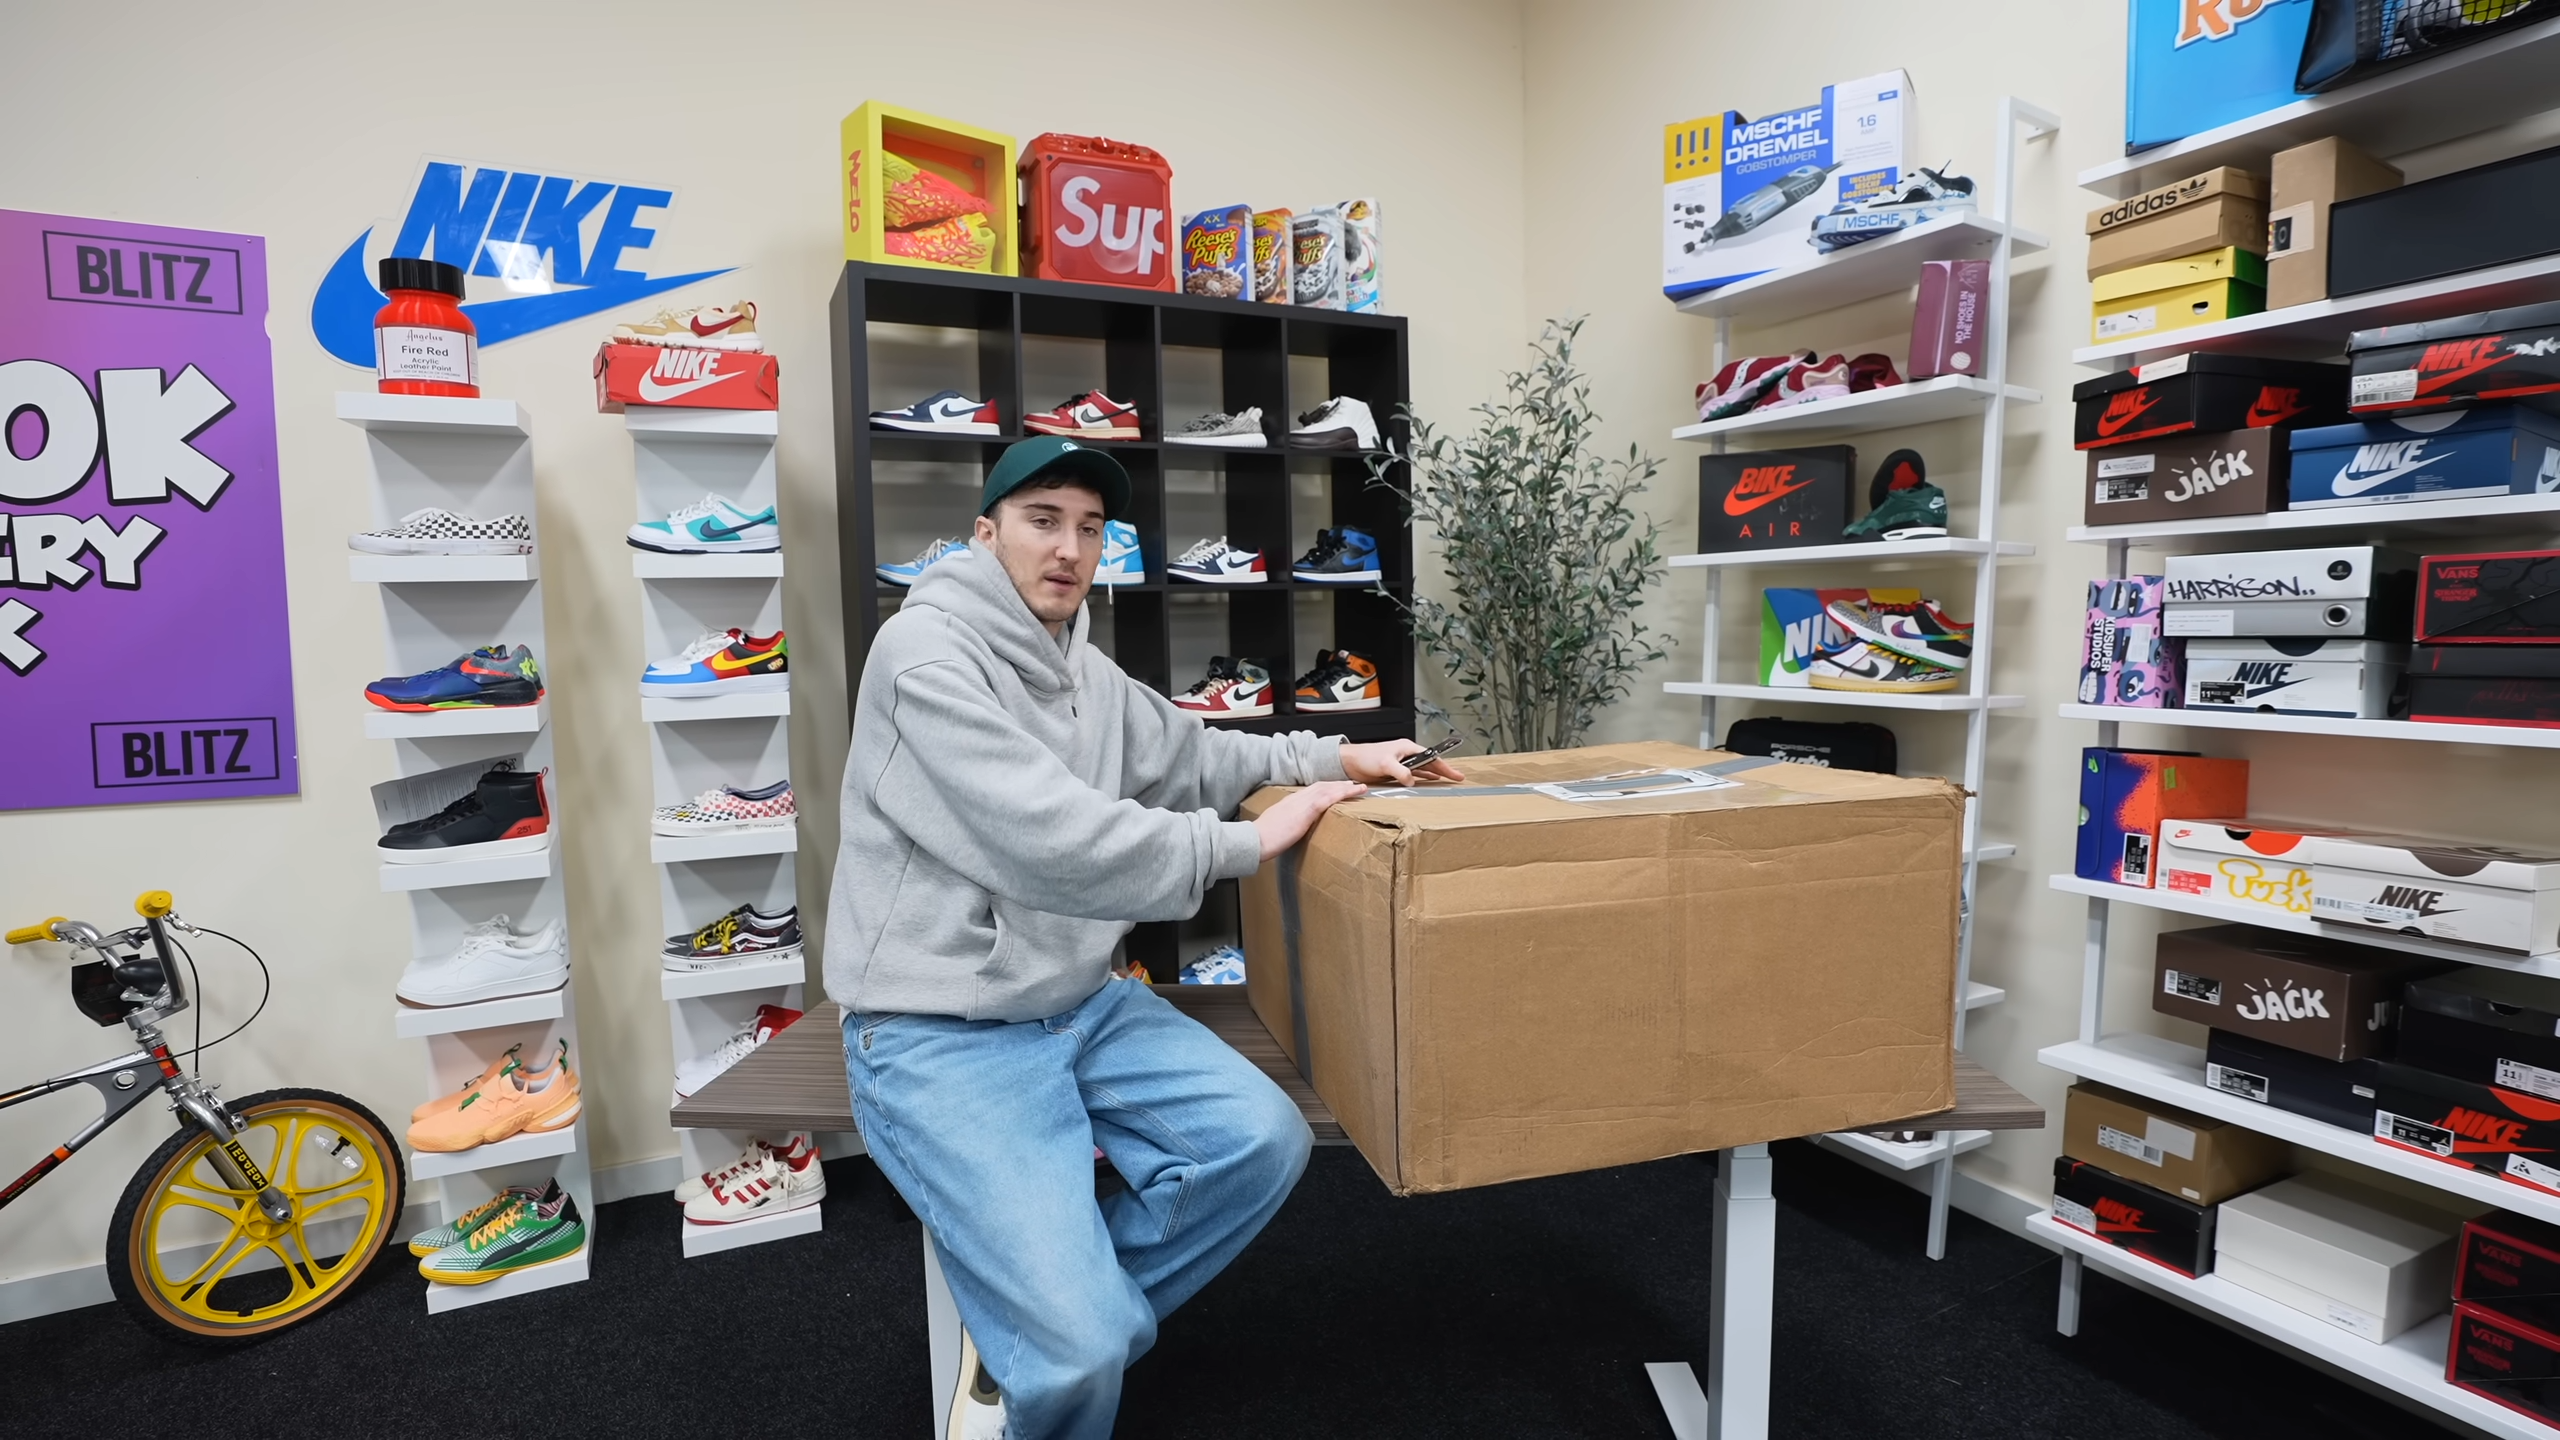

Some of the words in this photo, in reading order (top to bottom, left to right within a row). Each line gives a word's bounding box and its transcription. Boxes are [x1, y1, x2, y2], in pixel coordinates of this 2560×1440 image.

[1731, 109, 1823, 146] MSCHF
[1725, 129, 1829, 166] DREMEL
[1736, 150, 1817, 175] GOBSTOMPER
[390, 161, 674, 281] NIKE
[1843, 213, 1900, 229] MSCHF
[2100, 187, 2178, 227] adidas
[1055, 175, 1164, 274] Sup
[1186, 229, 1237, 250] Reese's
[1191, 243, 1234, 267] Puffs
[76, 245, 213, 304] BLITZ
[1966, 292, 1977, 322] HOUSE
[402, 345, 423, 355] Fire
[427, 346, 449, 357] Red
[412, 357, 439, 365] Acrylic
[652, 348, 722, 380] NIKE
[2417, 335, 2503, 373] NIKE
[400, 363, 429, 371] Leather
[432, 364, 452, 373] Paint
[2106, 386, 2151, 418] NIKE
[2256, 385, 2301, 411] NIKE
[2347, 439, 2429, 473] NIKE
[1735, 465, 1797, 494] BIKE
[2164, 449, 2254, 502] JACK
[1739, 522, 1801, 538] AIR
[0, 513, 168, 591] RY
[2436, 565, 2481, 579] VANS
[2090, 618, 2104, 669] STUDIOS
[2101, 616, 2116, 672] KIDSUPER
[2233, 662, 2293, 685] NIKE
[121, 729, 251, 779] BLITZ
[1770, 743, 1831, 754] PORSCHE
[517, 825, 532, 835] 251
[2377, 885, 2445, 912] NIKE
[2236, 985, 2331, 1022] JACK
[2441, 1106, 2529, 1148] NIKE
[2093, 1196, 2144, 1228] NIKE
[2470, 1324, 2514, 1351] VANS
